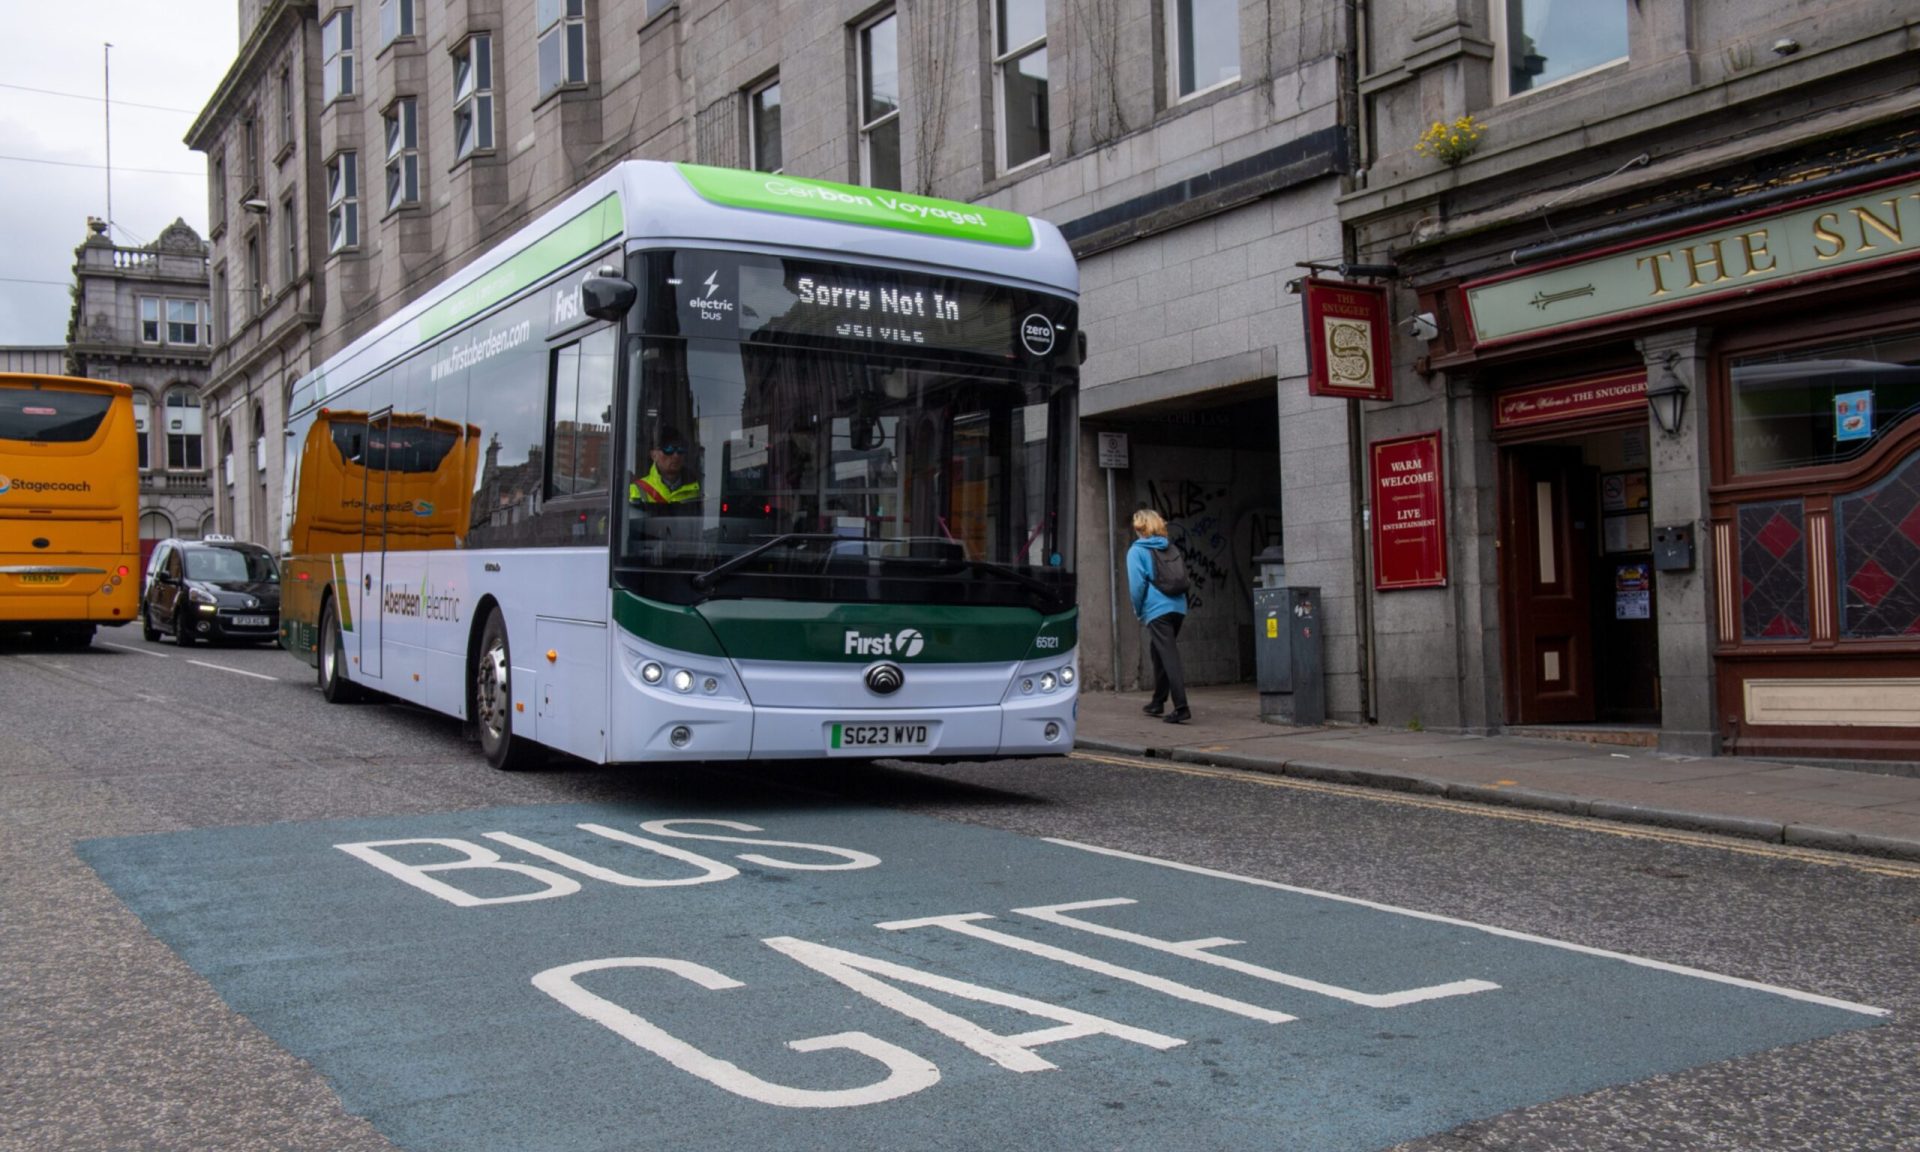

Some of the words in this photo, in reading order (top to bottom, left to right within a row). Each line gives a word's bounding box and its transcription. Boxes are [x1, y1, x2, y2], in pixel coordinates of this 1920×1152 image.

[764, 181, 874, 208] Carbon
[876, 195, 987, 227] Voyage!
[1636, 228, 1778, 297] THE
[1812, 191, 1920, 260] SN
[554, 284, 579, 325] First
[689, 297, 734, 311] electric
[798, 277, 871, 310] Sorry
[880, 287, 925, 317] Not
[934, 293, 959, 320] In
[1337, 294, 1356, 305] THE
[701, 309, 722, 321] bus
[1321, 303, 1371, 316] SNUGGERY
[1026, 325, 1050, 337] zero
[431, 319, 530, 382] www.firstaberdeen.com
[1572, 391, 1593, 402] THE
[1391, 459, 1422, 472] WARM
[11, 479, 91, 493] Stagecoach
[1381, 472, 1435, 488] WELCOME
[1397, 509, 1421, 521] LIVE
[1383, 518, 1436, 531] ENTERTAINMENT
[384, 583, 420, 617] Aberdeen
[426, 583, 460, 623] electric
[845, 631, 893, 655] First
[1036, 636, 1059, 648] 65121
[844, 726, 889, 745] SG23
[894, 725, 927, 744] WVD
[334, 819, 882, 908] BUS
[530, 898, 1502, 1108] GATE
